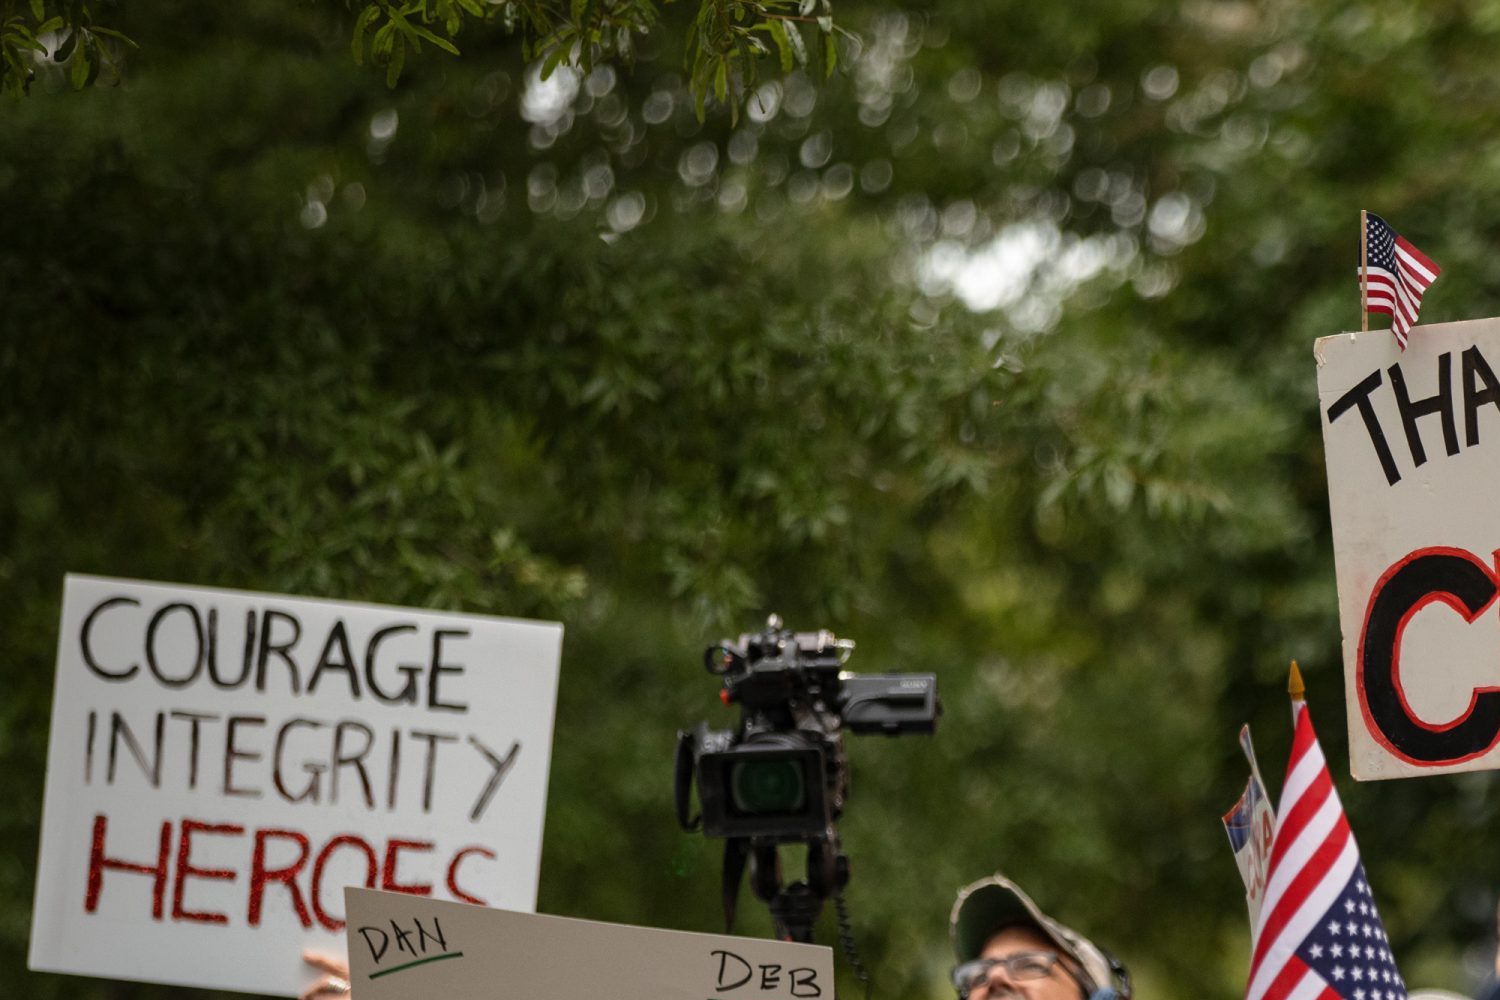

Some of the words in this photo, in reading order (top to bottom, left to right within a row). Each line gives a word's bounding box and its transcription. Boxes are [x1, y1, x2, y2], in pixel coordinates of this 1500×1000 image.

[79, 596, 471, 713] COURAGE
[85, 711, 521, 822] INTEGRITY
[85, 815, 496, 931] HEROES
[358, 917, 448, 964] DAN
[711, 949, 822, 998] DEB
